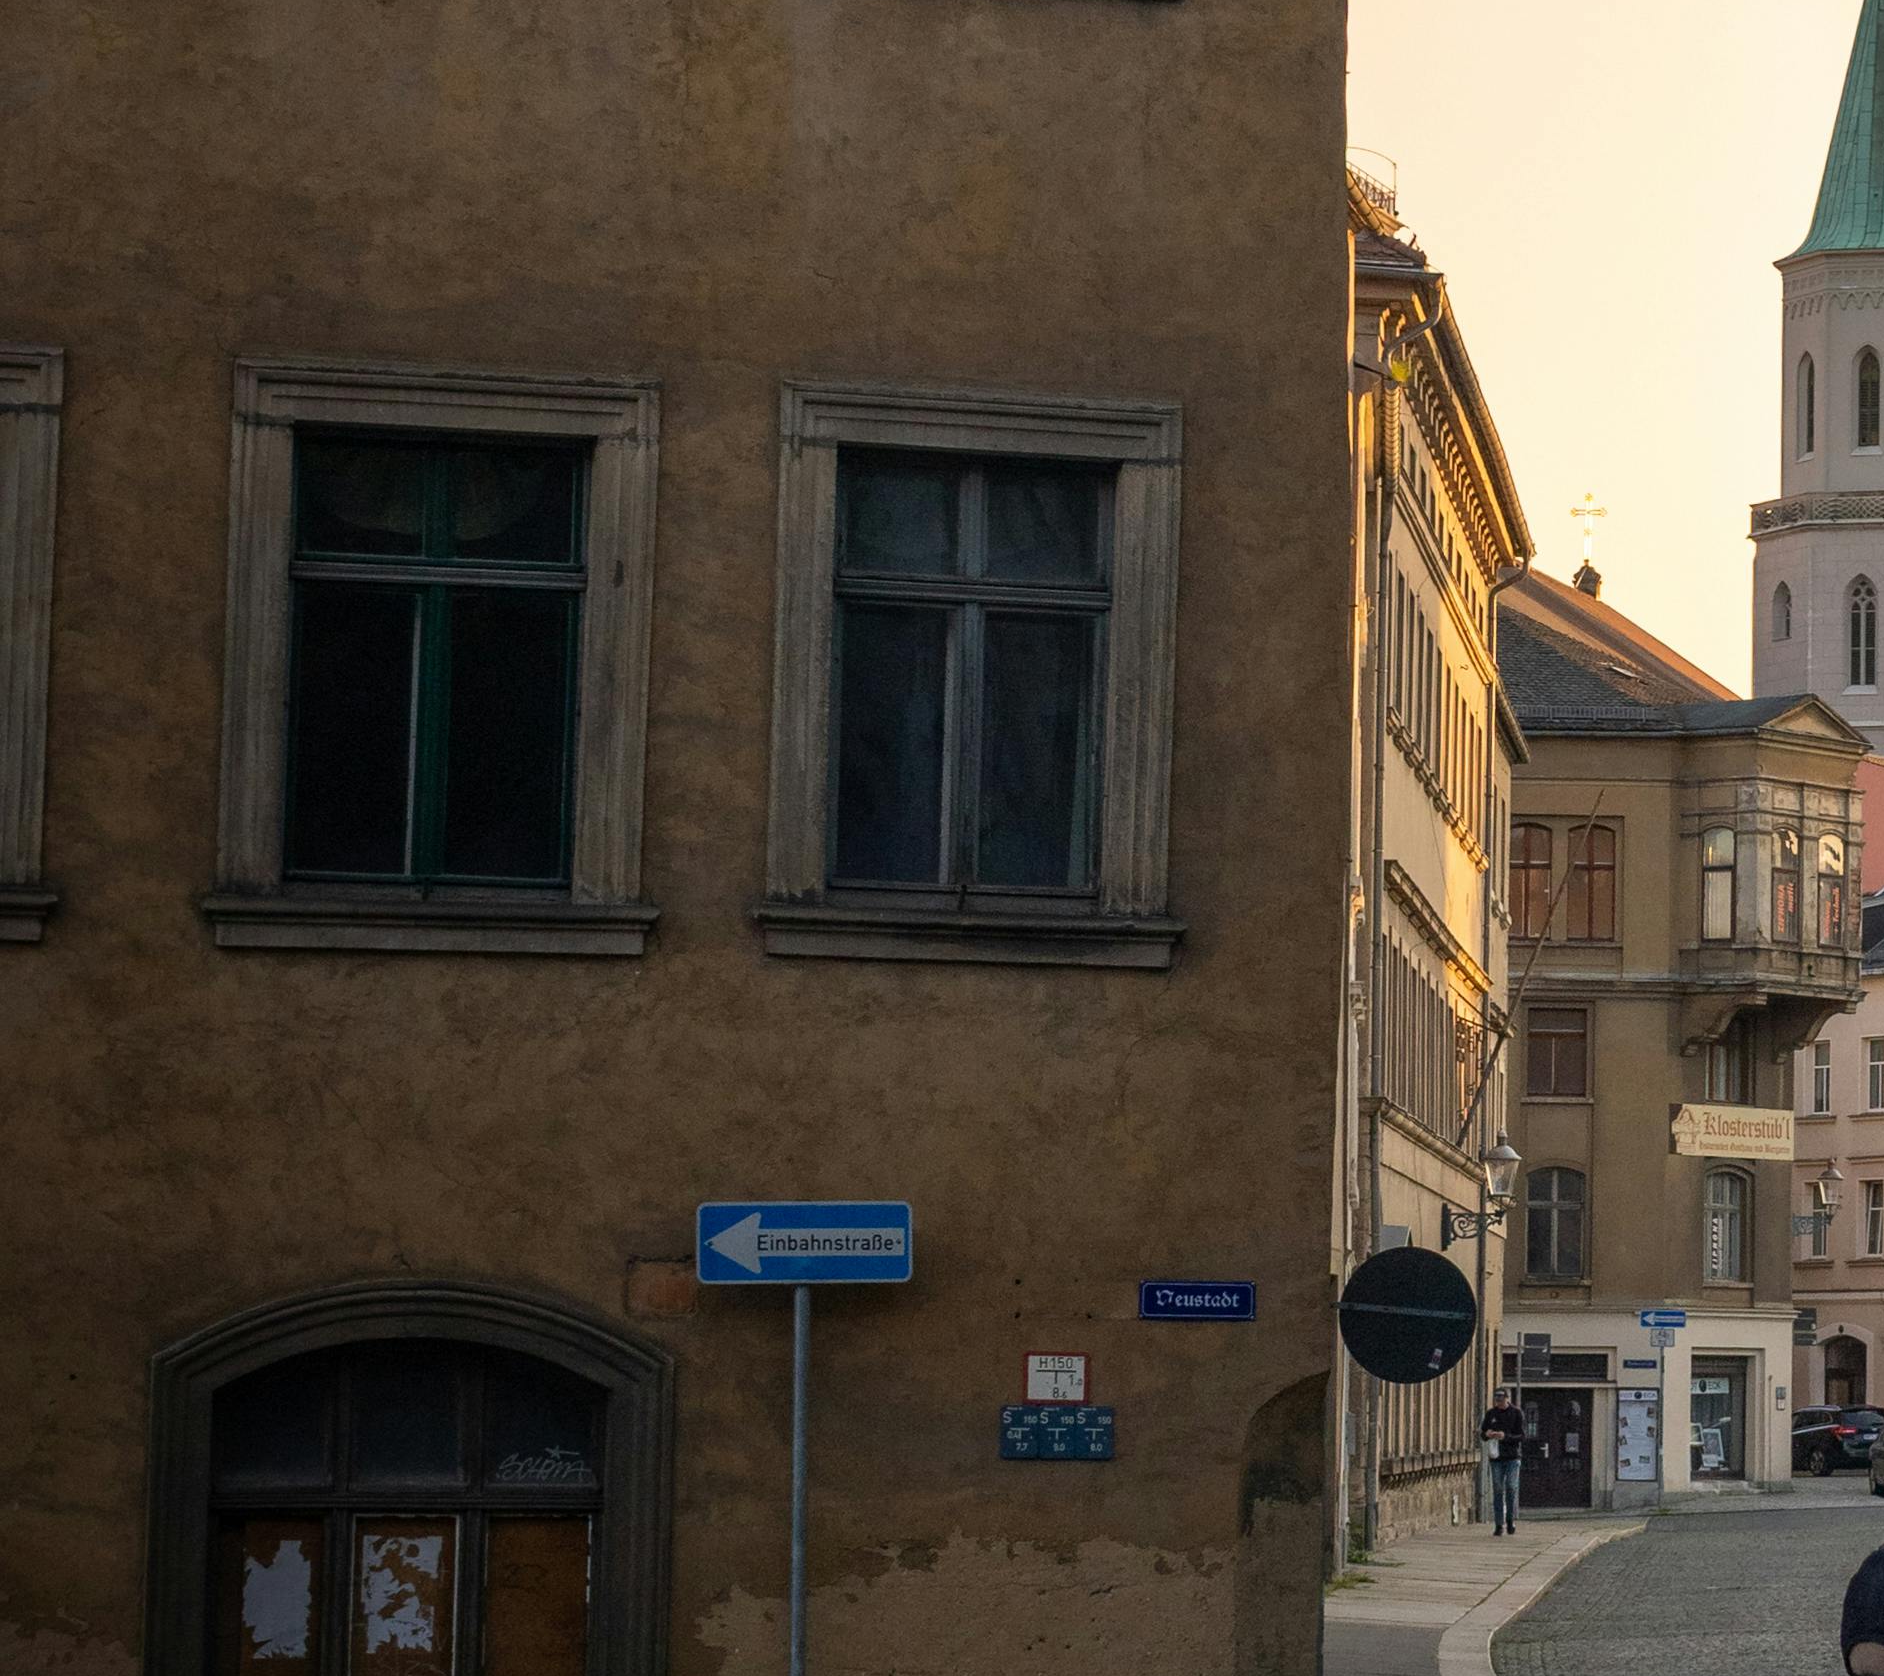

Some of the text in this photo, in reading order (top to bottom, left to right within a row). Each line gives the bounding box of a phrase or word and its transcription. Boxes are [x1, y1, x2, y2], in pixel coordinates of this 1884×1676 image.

[757, 1234, 893, 1251] Einbahnstraße
[1156, 1289, 1240, 1308] Neustadt
[1003, 1411, 1012, 1424] S
[1040, 1411, 1049, 1424] S
[1077, 1412, 1086, 1424] S
